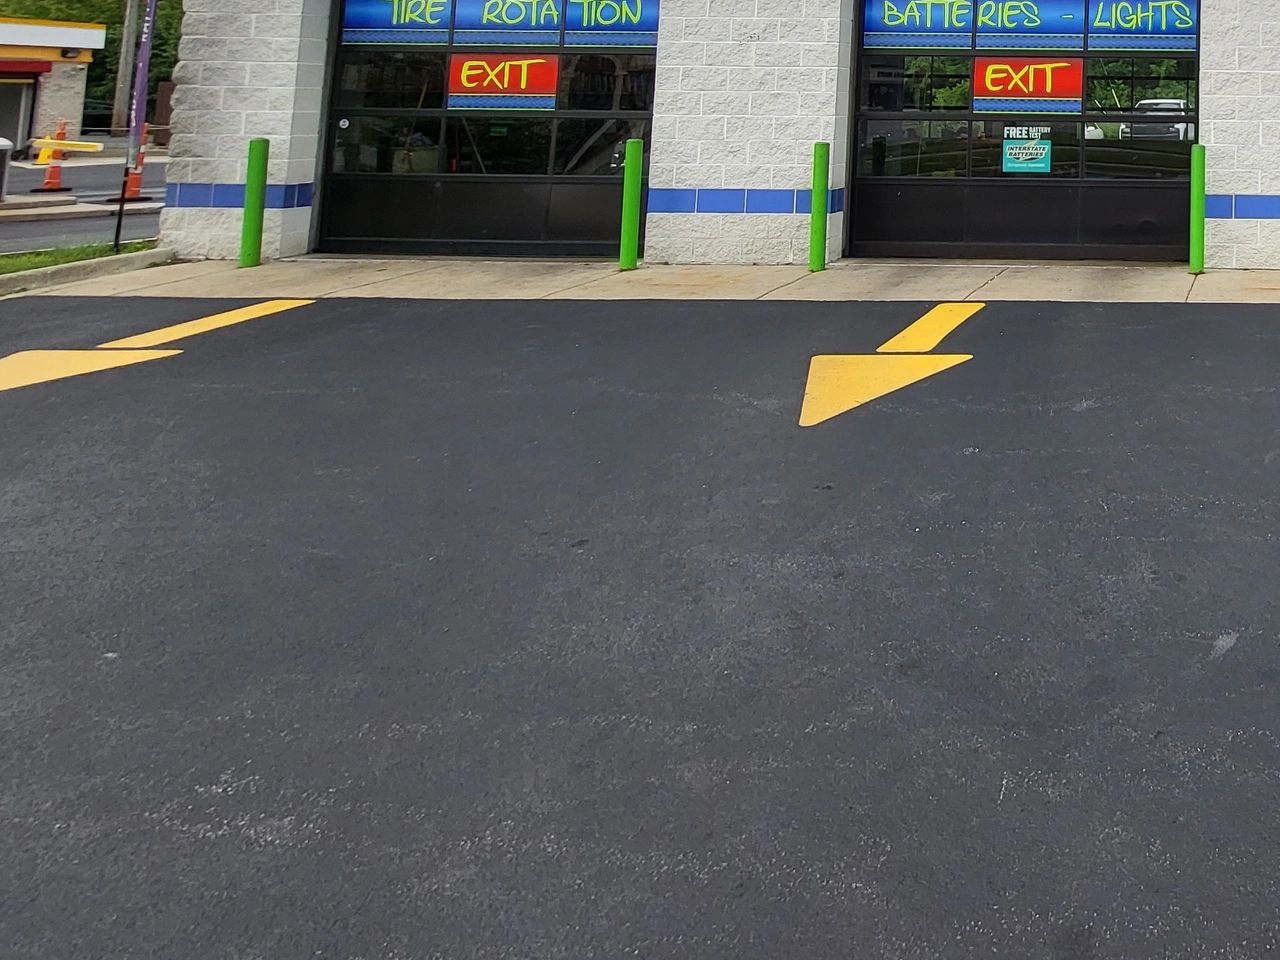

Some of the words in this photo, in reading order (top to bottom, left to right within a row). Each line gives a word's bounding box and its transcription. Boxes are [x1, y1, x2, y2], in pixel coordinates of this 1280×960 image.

[1093, 0, 1193, 31] LIGHTS
[459, 58, 547, 90] EXIT
[984, 62, 1071, 95] EXIT
[1003, 126, 1029, 139] FREE
